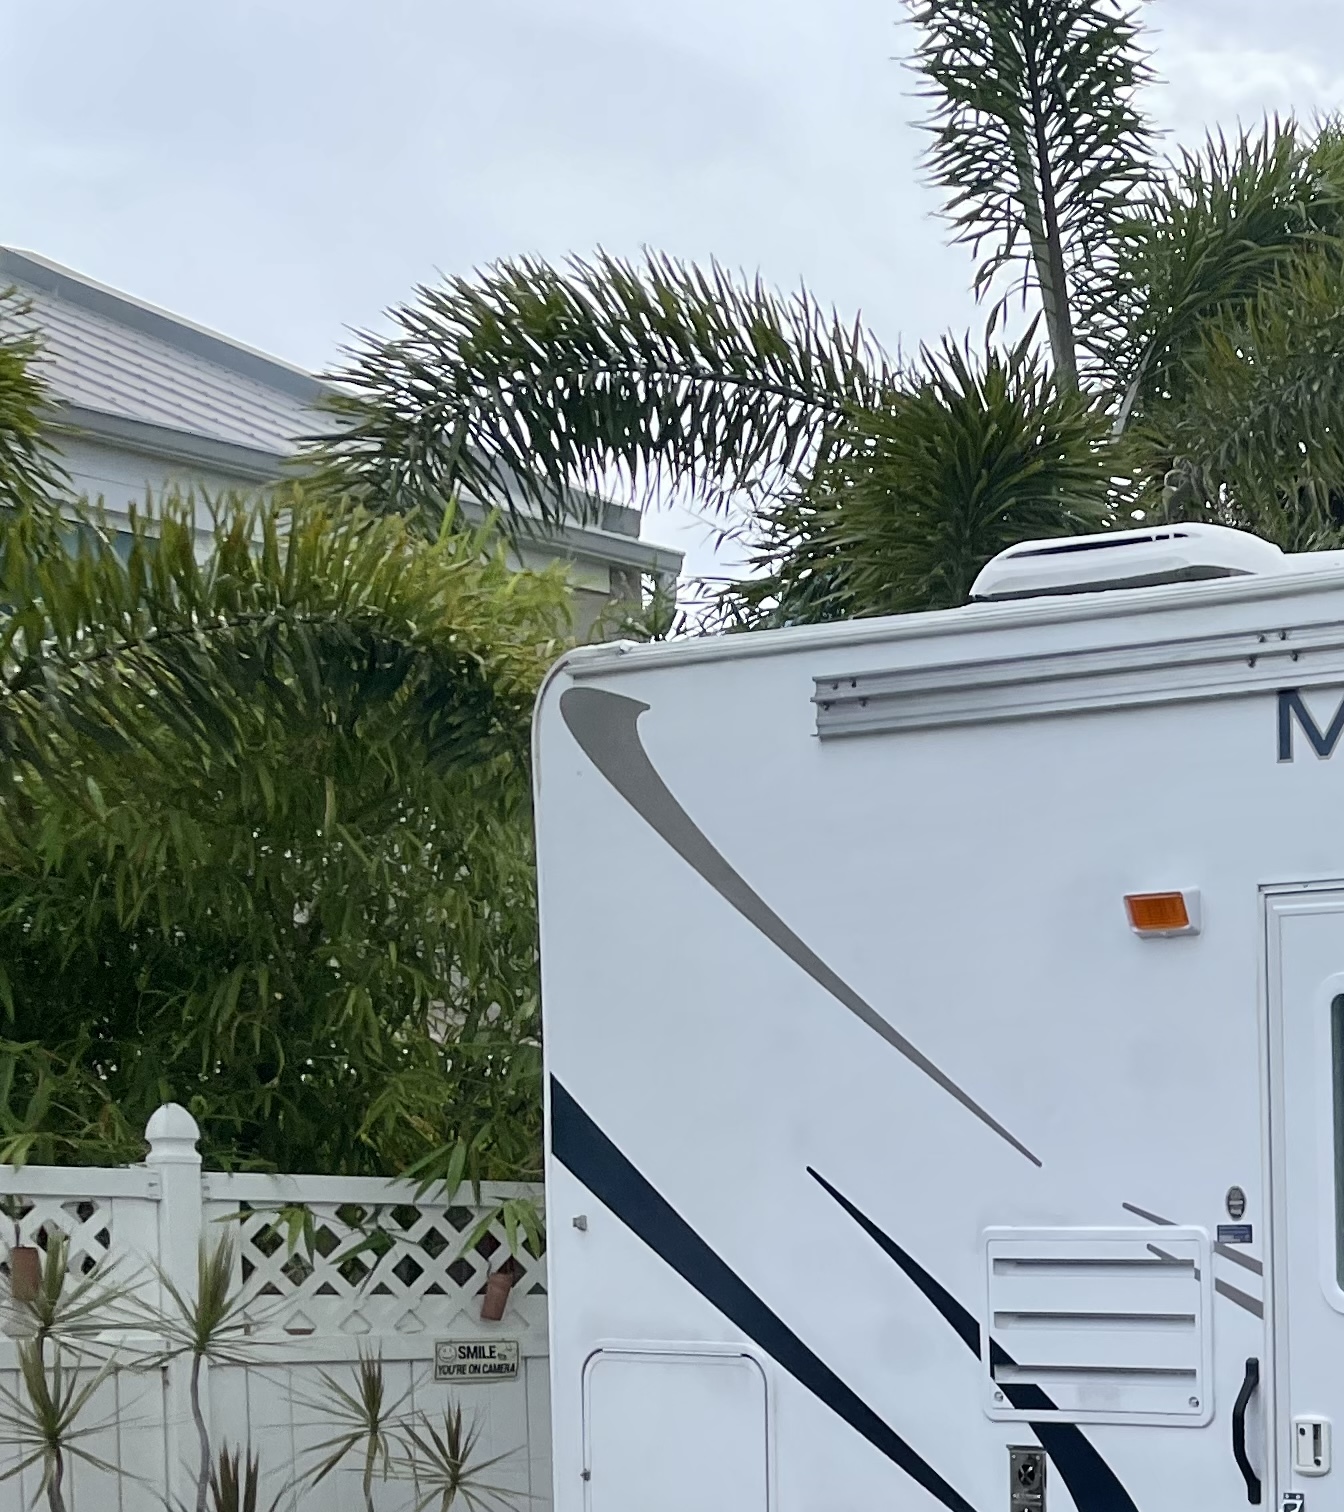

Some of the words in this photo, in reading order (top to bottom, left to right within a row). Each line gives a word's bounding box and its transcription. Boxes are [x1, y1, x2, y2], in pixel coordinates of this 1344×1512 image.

[458, 1345, 497, 1359] SMILE
[438, 1364, 467, 1375] YOU'RE
[468, 1363, 481, 1374] ON
[482, 1363, 515, 1374] CAMERA
